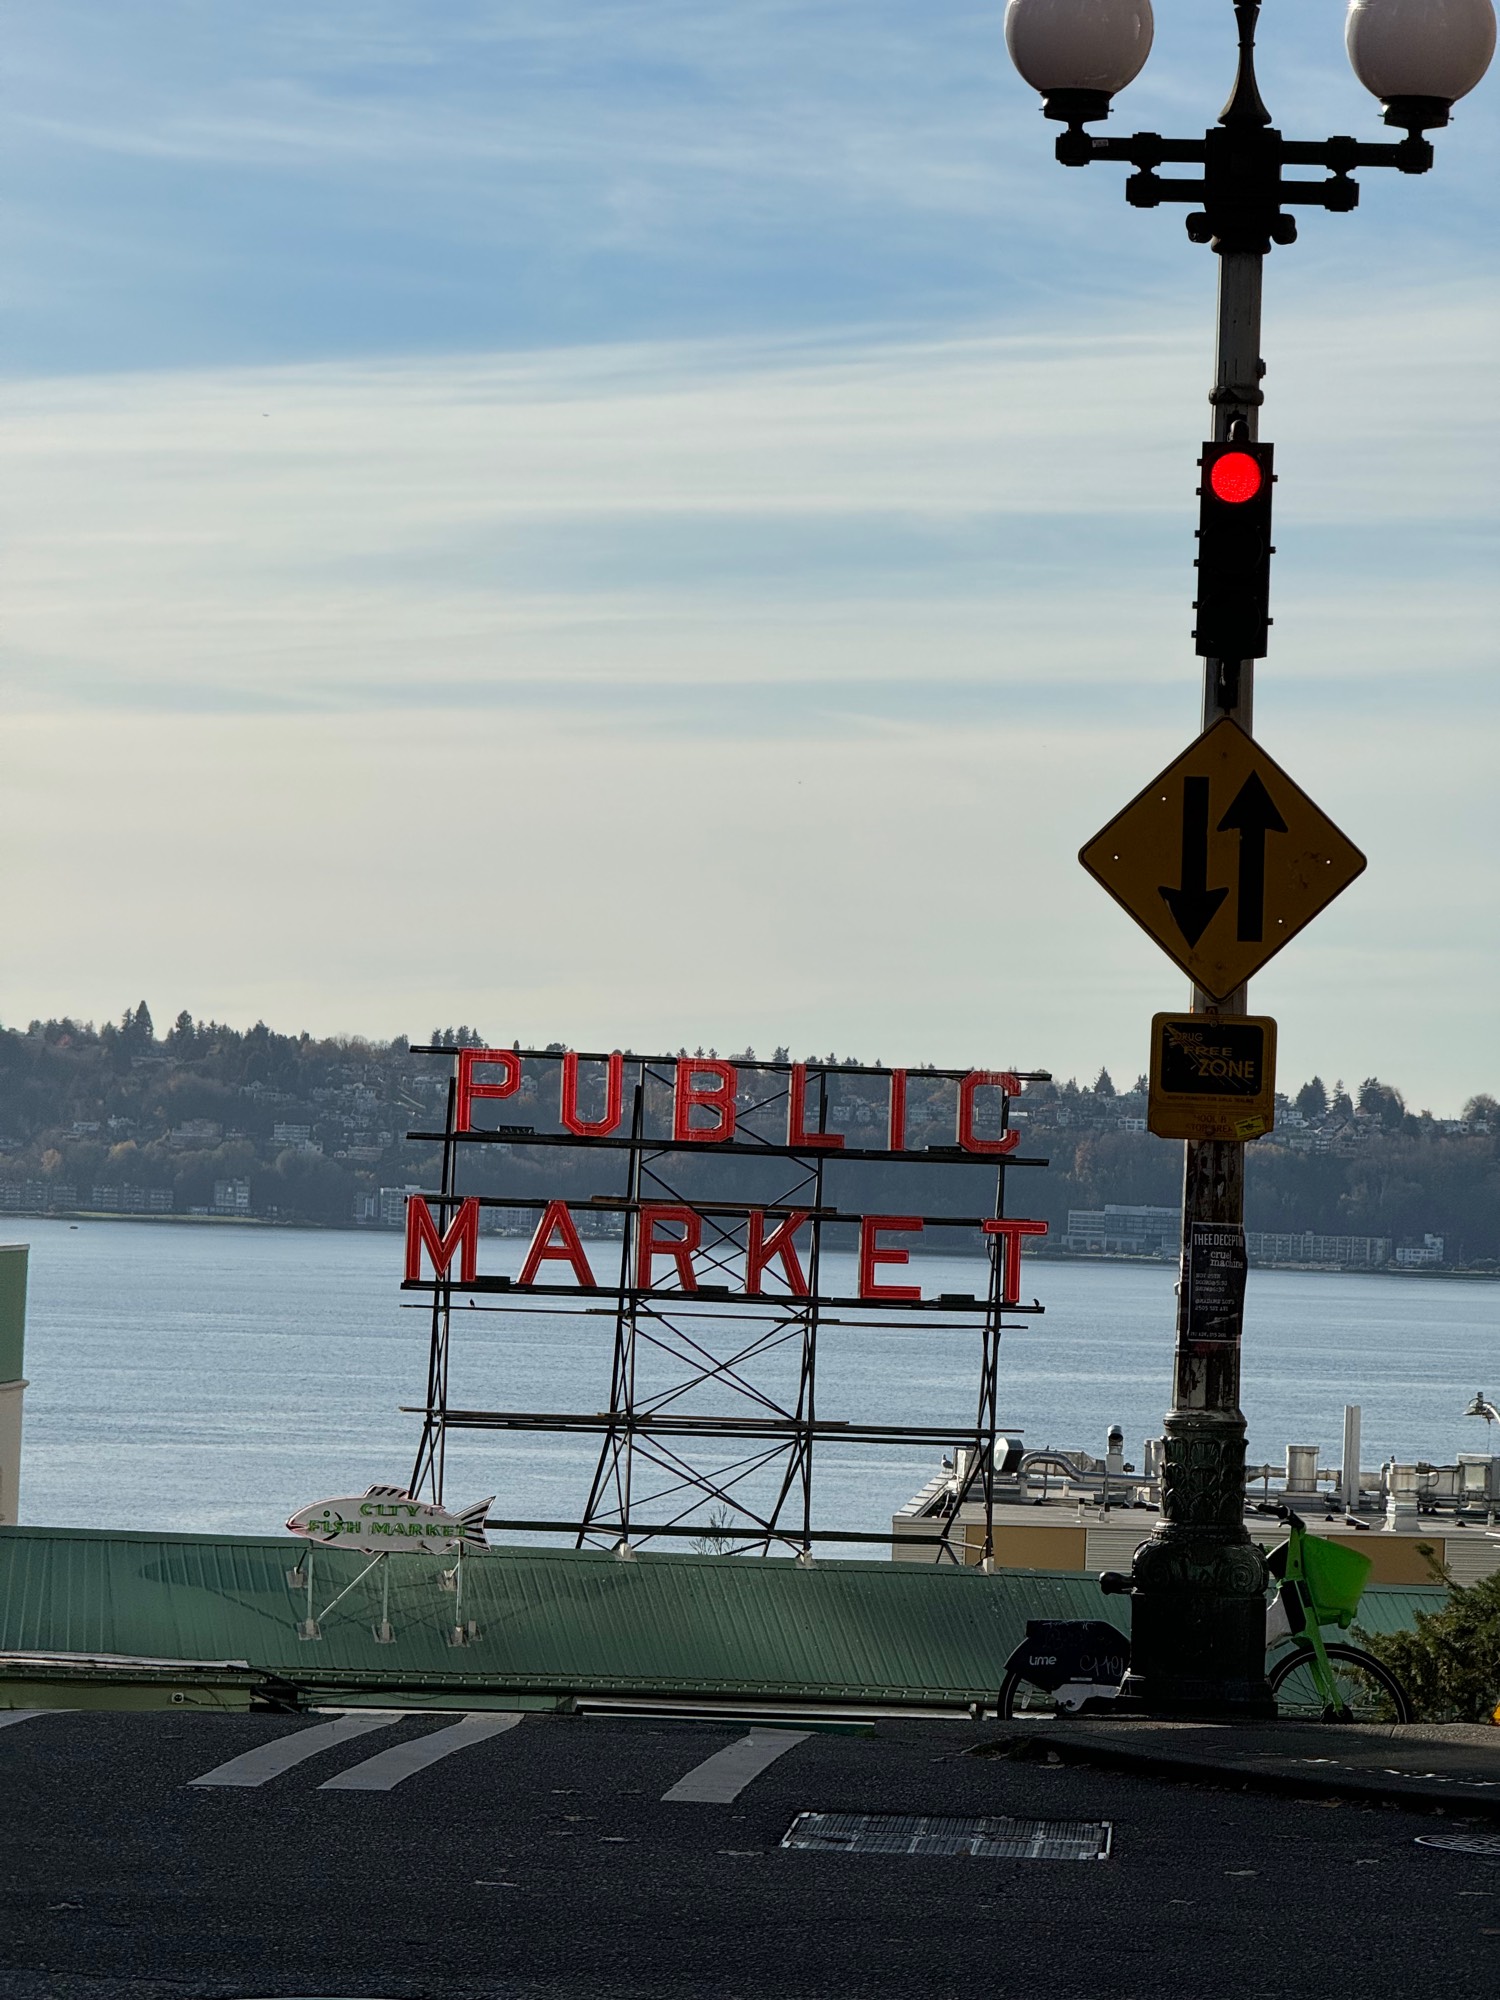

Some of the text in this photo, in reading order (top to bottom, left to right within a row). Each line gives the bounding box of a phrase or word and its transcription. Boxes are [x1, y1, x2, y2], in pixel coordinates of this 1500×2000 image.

[1176, 1032, 1204, 1042] DRUG
[1183, 1046, 1233, 1057] FREE
[1198, 1058, 1255, 1078] ZONE
[455, 1047, 1021, 1155] PUBLIC
[1194, 1233, 1213, 1246] THEE
[405, 1195, 1049, 1304] MARKET
[1210, 1250, 1232, 1260] cruel
[1210, 1258, 1244, 1269] machine
[360, 1503, 421, 1517] CITY
[307, 1519, 467, 1538] FISH MARKET
[1029, 1655, 1058, 1666] Lime
